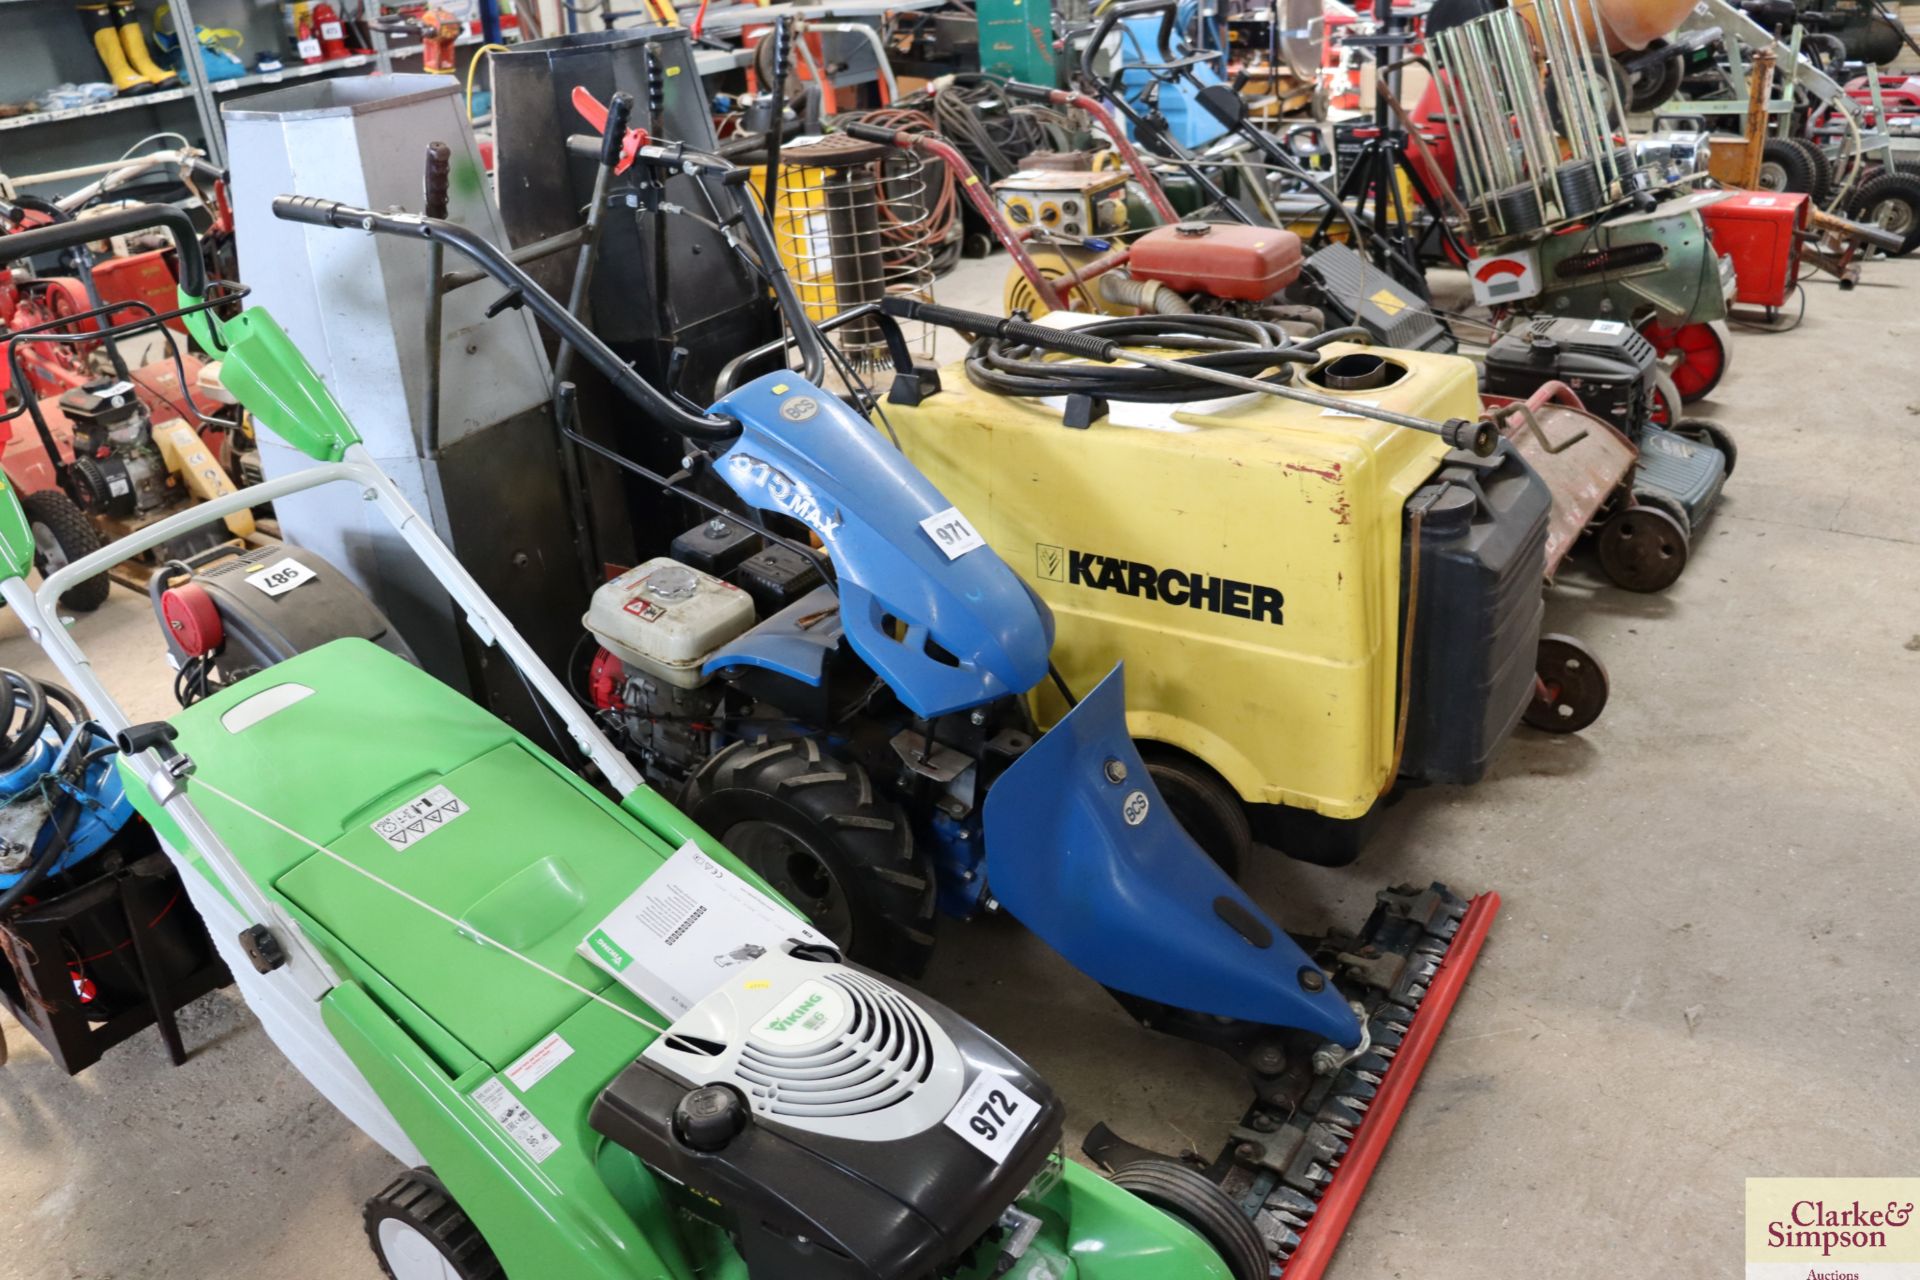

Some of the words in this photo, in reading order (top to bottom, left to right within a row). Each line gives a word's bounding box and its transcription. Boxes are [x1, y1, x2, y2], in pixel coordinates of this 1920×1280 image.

[785, 399, 815, 419] BCS
[788, 494, 839, 542] MAX
[935, 520, 971, 545] 971
[264, 567, 299, 588] 987
[1069, 550, 1284, 625] KÄRCHER
[1126, 794, 1147, 822] BCS
[767, 992, 824, 1032] VIKING
[969, 1089, 1019, 1141] 972
